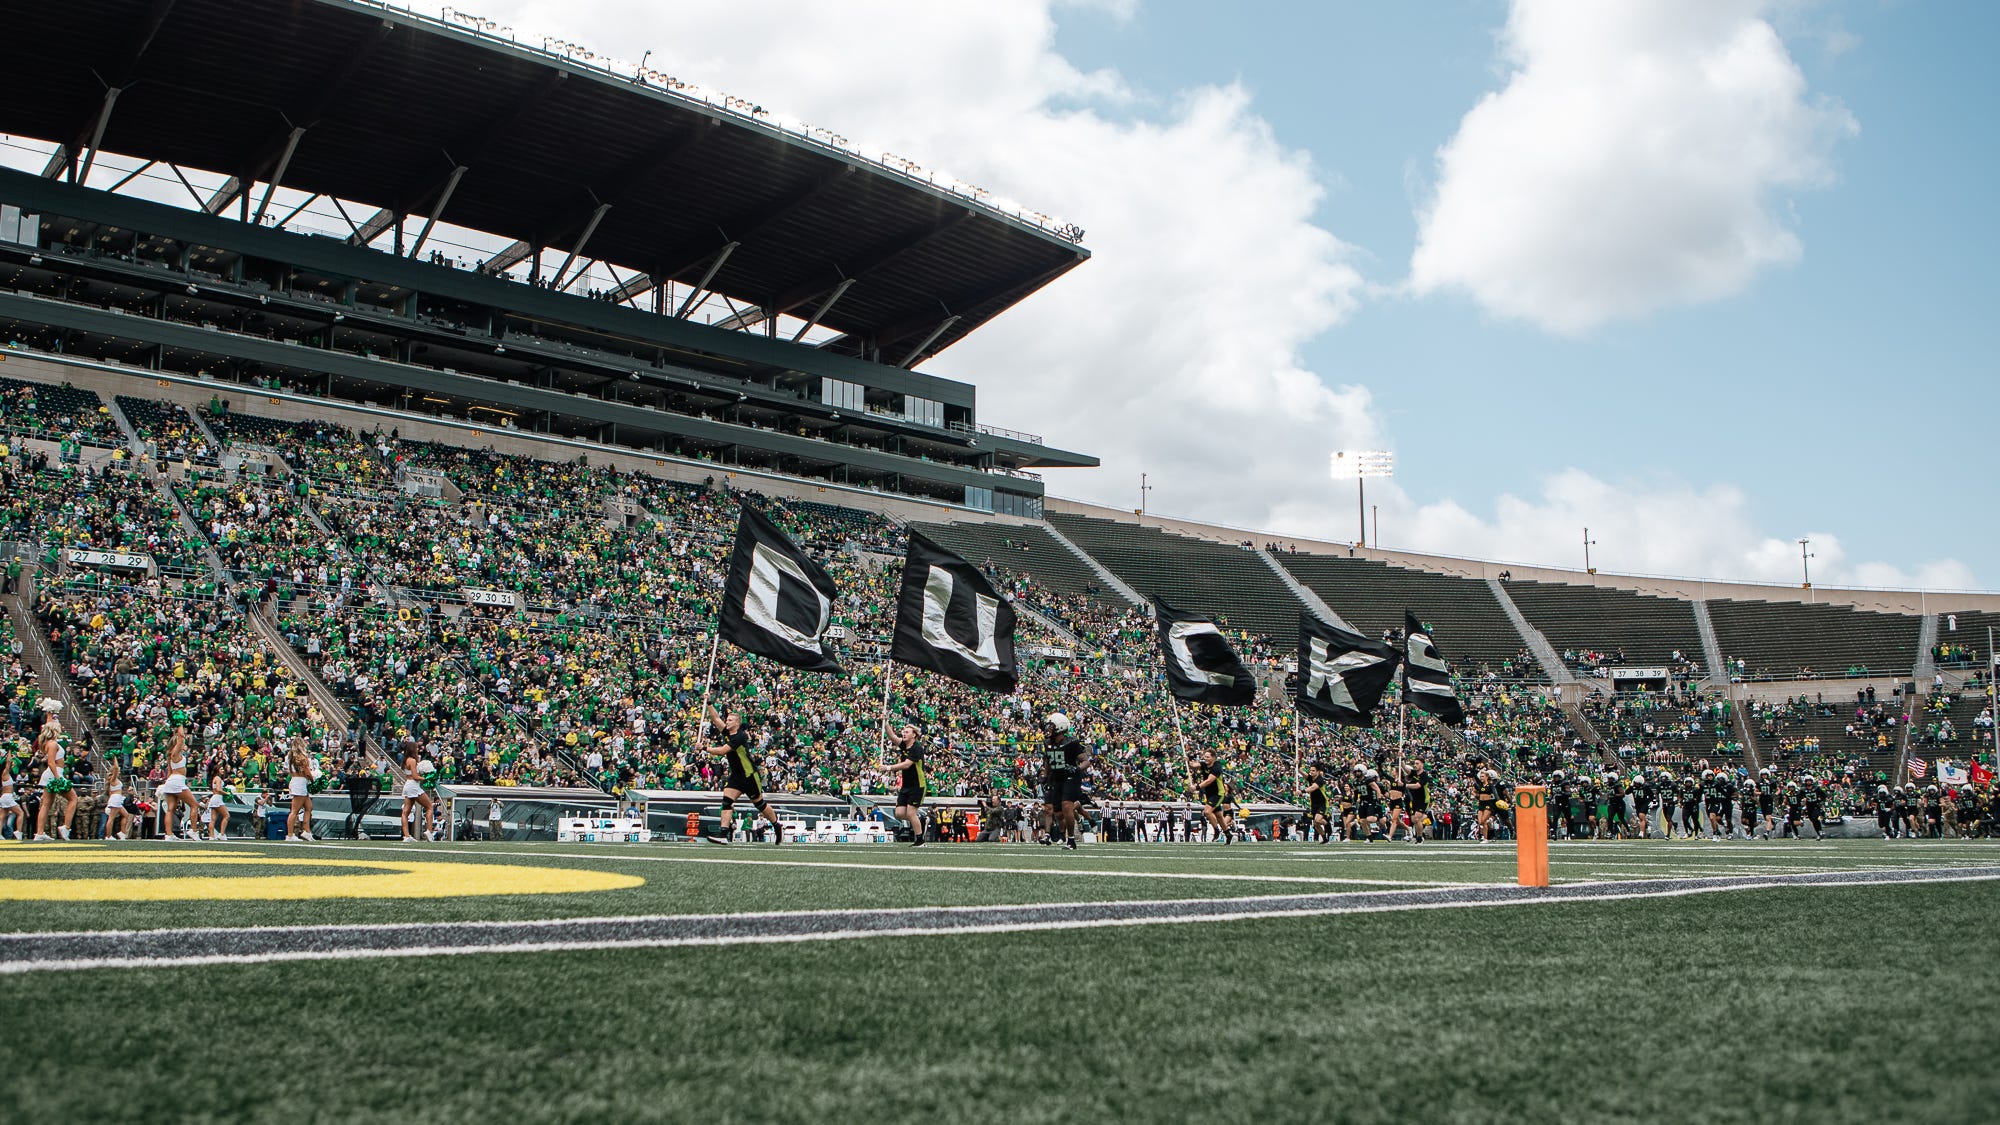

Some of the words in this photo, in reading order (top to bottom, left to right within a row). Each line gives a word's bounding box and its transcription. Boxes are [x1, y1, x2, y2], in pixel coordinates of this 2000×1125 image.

[624, 505, 633, 513] 32
[74, 551, 89, 562] 27
[101, 553, 116, 564] 28
[128, 556, 142, 567] 29
[485, 593, 497, 602] 30
[502, 595, 512, 604] 31
[742, 541, 830, 654] D
[922, 565, 1000, 670] U
[834, 628, 843, 636] 33
[1169, 621, 1235, 688] C
[1307, 636, 1388, 713] K
[1618, 670, 1627, 678] 37
[1633, 789, 1644, 799] 74
[1660, 789, 1672, 799] 22
[1703, 788, 1718, 799] 24
[1761, 786, 1770, 796] 91
[1583, 793, 1593, 802] 12
[1805, 792, 1817, 802] 53
